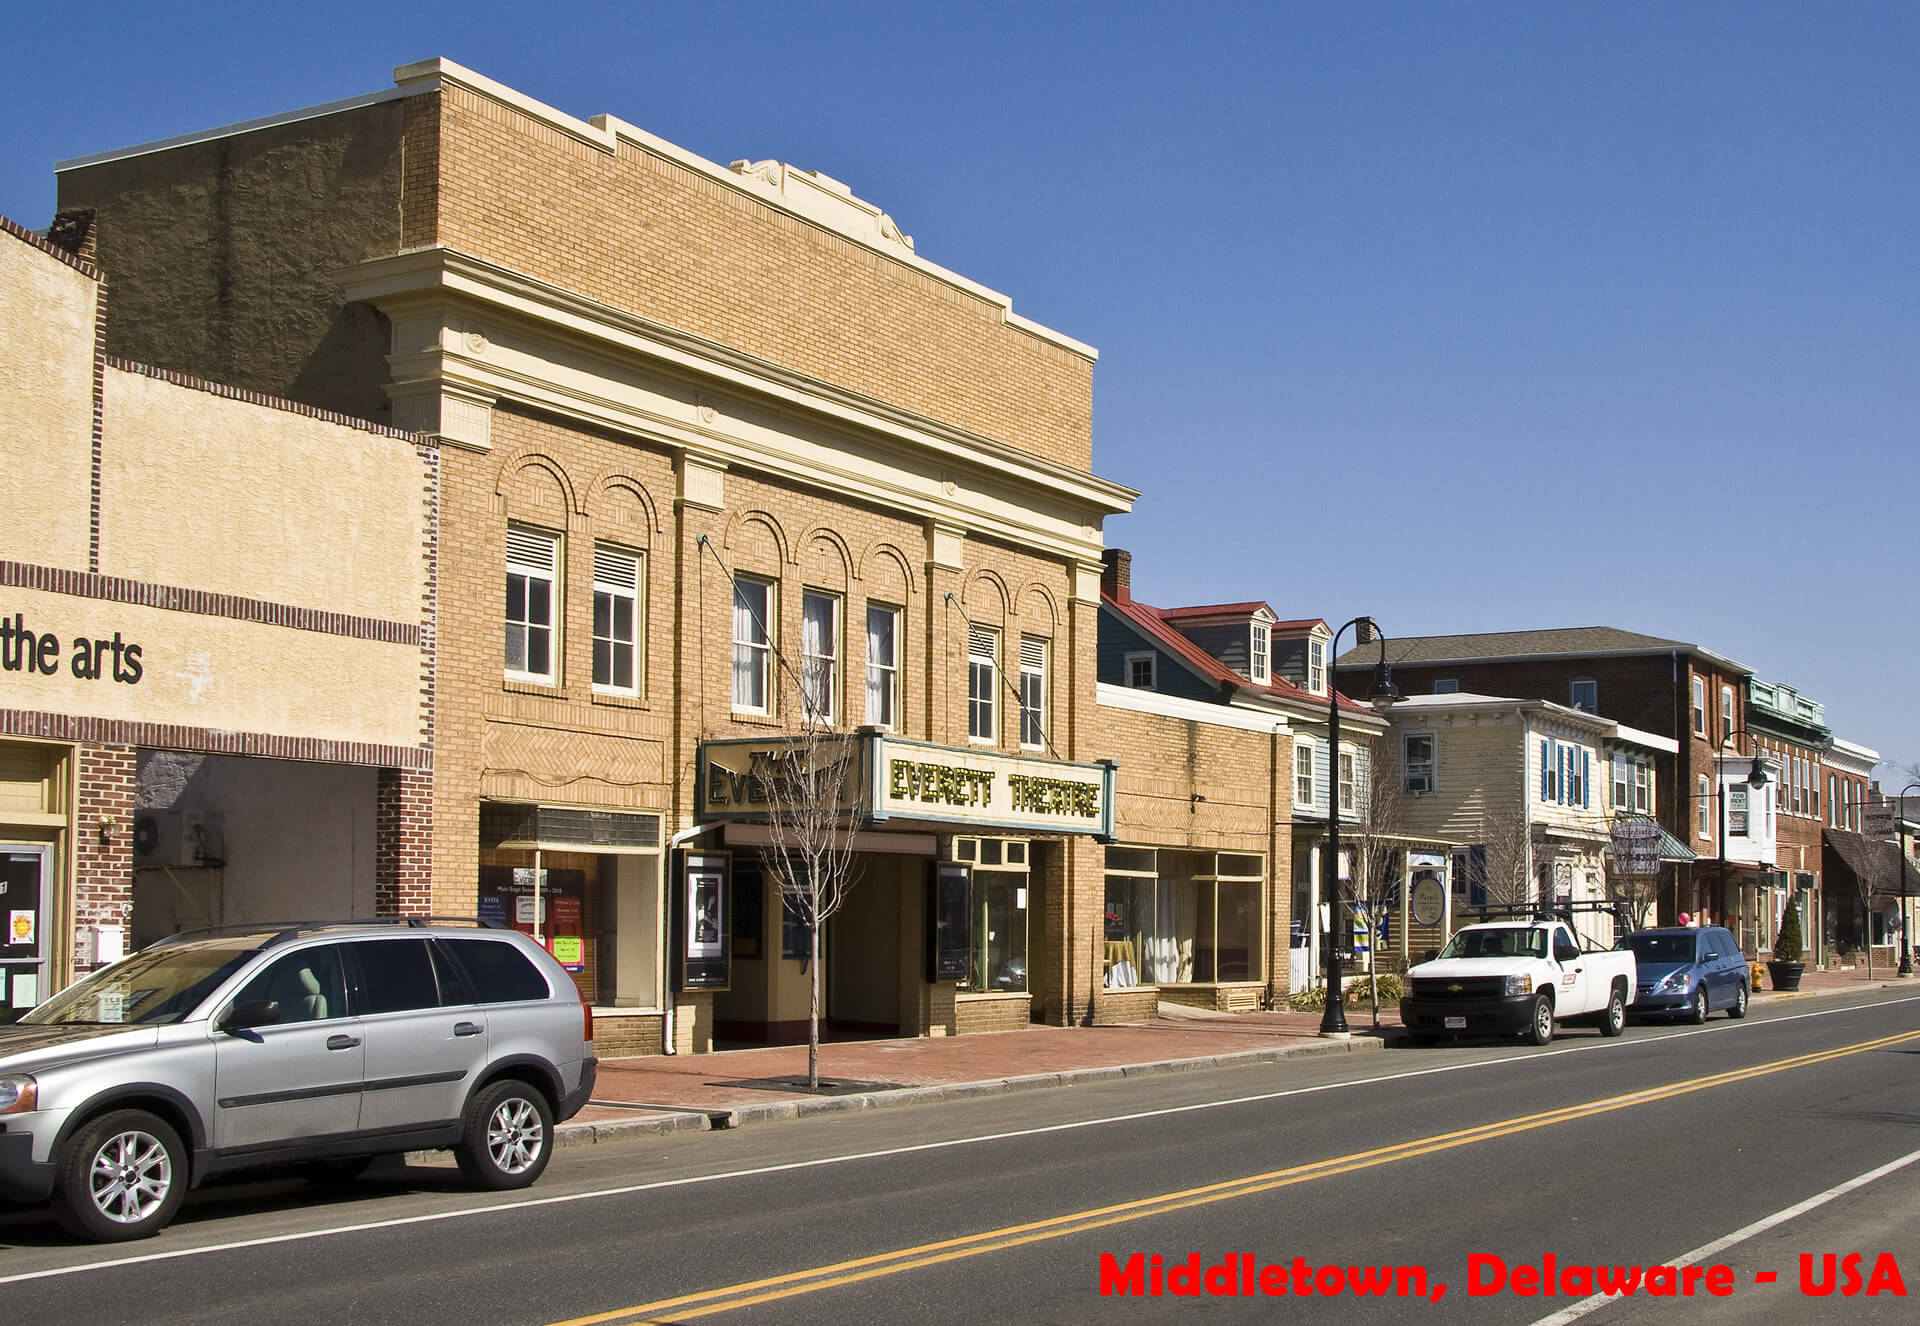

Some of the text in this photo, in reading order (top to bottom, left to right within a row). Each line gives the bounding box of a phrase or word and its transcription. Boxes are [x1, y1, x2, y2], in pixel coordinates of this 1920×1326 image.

[0, 613, 143, 684] the arts
[890, 759, 1100, 818] EVERETT THEATRE
